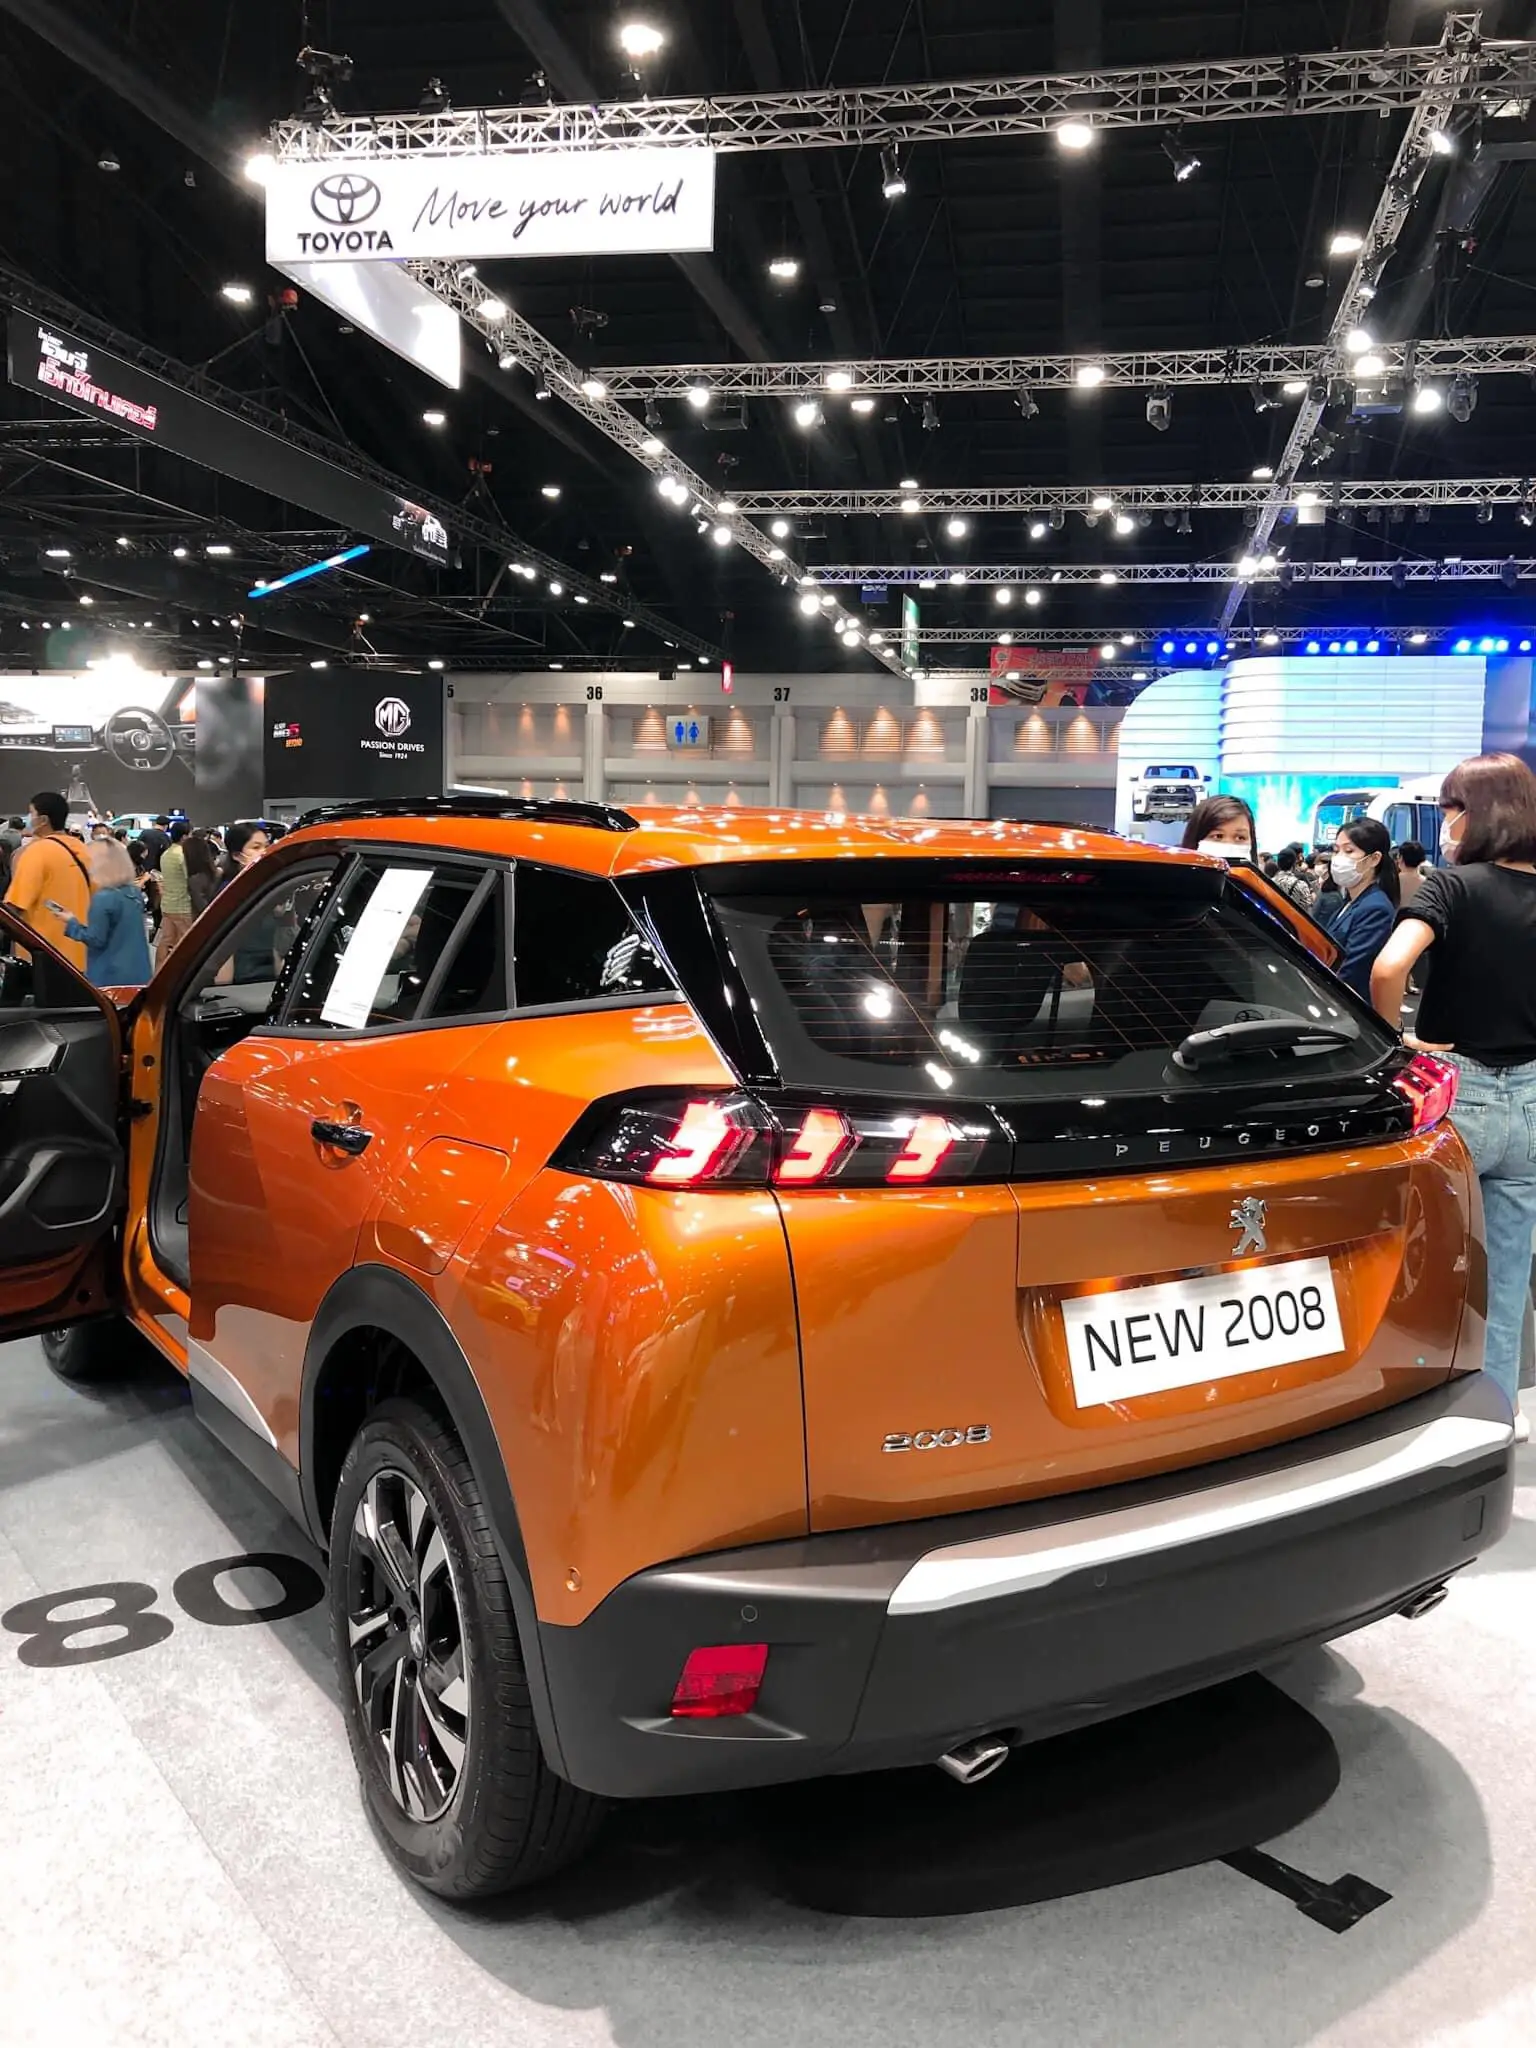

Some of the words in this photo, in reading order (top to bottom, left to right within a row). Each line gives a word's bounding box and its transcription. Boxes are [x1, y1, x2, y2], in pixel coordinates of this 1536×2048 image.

[412, 186, 508, 232] Move
[512, 197, 589, 239] your
[599, 178, 685, 216] world
[298, 230, 394, 254] TOYOTA
[586, 686, 603, 701] 36
[773, 687, 791, 702] 37
[970, 687, 988, 702] 38
[378, 700, 408, 733] MG
[360, 740, 396, 750] PASSION
[397, 743, 425, 752] DRIVES
[1115, 1121, 1350, 1157] PEUGEOT
[1084, 1305, 1205, 1371] NEW
[1220, 1286, 1326, 1348] 2008
[881, 1424, 992, 1453] 2008
